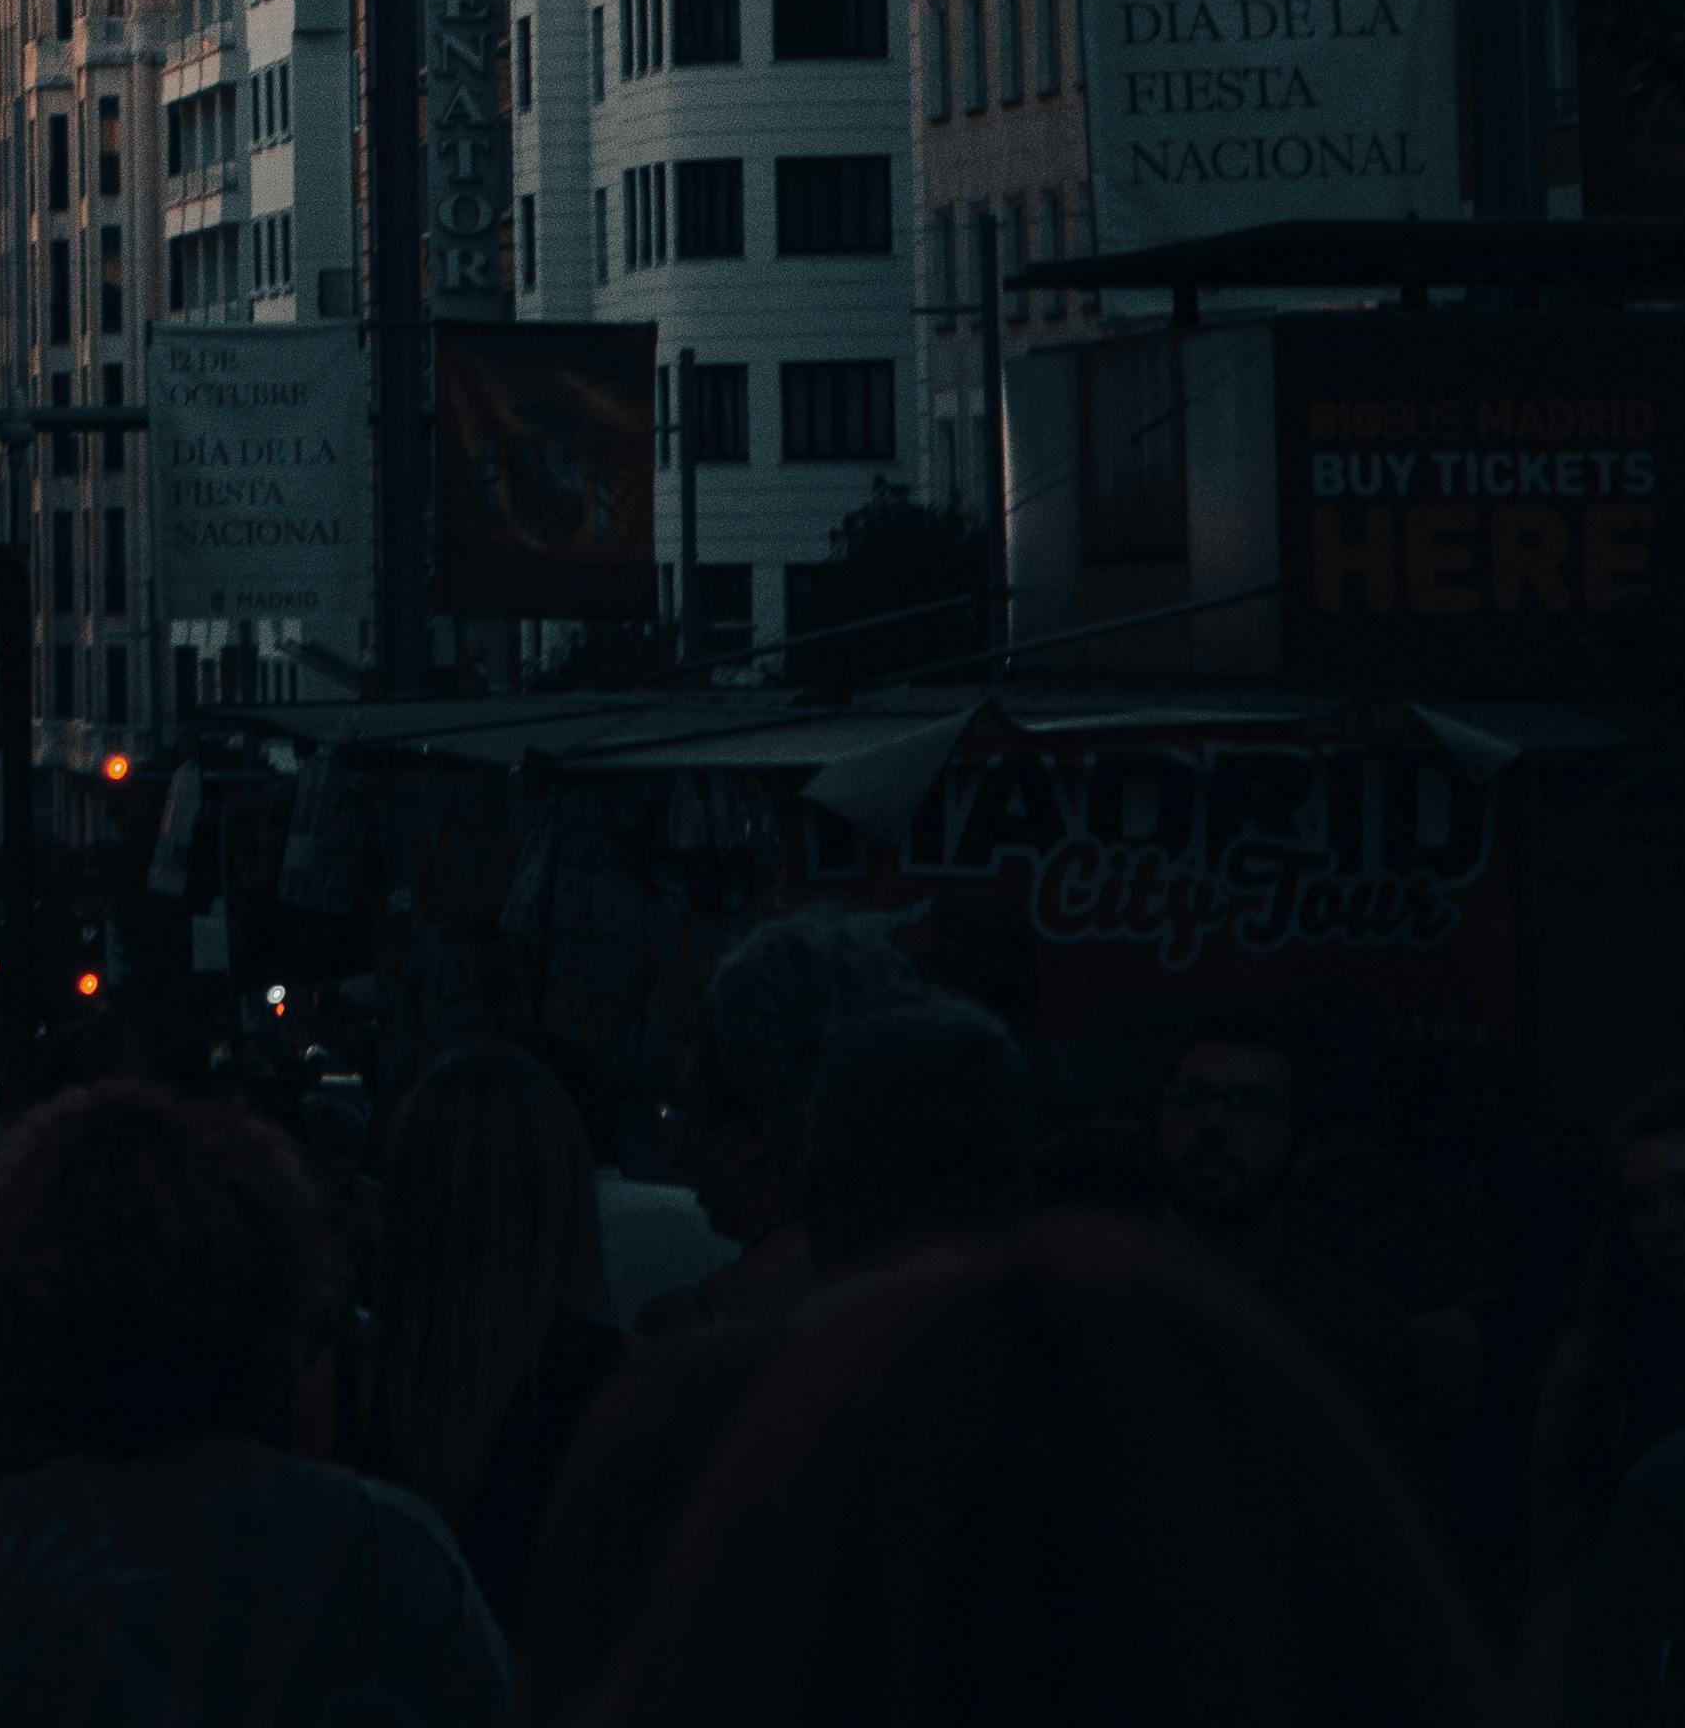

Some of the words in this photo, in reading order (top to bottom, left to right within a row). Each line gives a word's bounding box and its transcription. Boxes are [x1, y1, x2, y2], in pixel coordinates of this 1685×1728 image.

[1127, 67, 1318, 115] FIESTA
[1129, 132, 1425, 186] NACIONAL
[198, 348, 239, 373] DE
[169, 382, 311, 408] OCTUBRE
[1476, 399, 1655, 439] MADRID
[172, 433, 231, 466] DÍA
[241, 436, 287, 466] DE
[292, 436, 338, 466] LA
[1312, 452, 1418, 497] BUY
[1431, 450, 1657, 497] TICKETS
[173, 477, 286, 508] FIESTA
[175, 518, 352, 549] NACIONAL
[1313, 503, 1656, 614] HERE
[237, 590, 319, 610] MADRID
[1031, 834, 1229, 971] City
[1221, 836, 1463, 955] Tour
